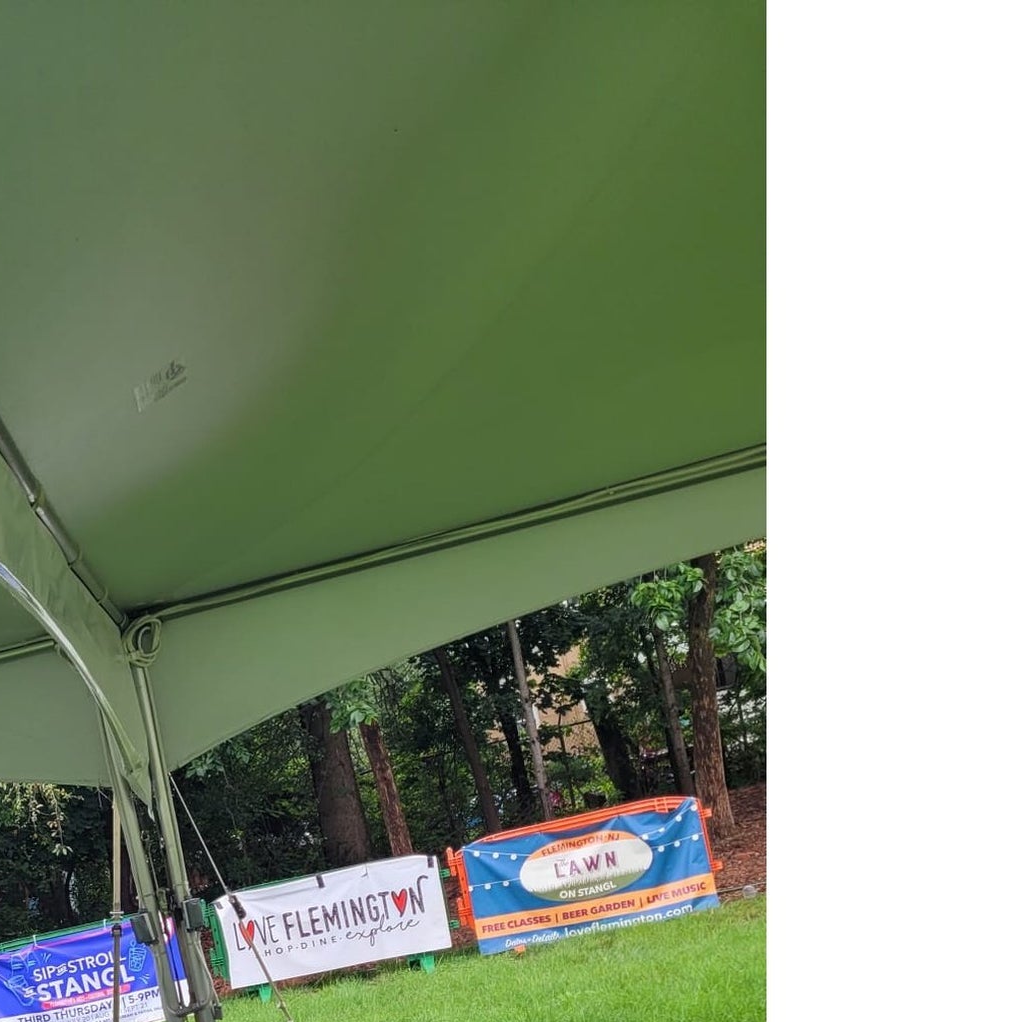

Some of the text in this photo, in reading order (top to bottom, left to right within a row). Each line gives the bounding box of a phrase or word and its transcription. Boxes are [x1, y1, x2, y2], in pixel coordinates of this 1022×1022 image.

[554, 851, 618, 878] LAWN
[559, 881, 618, 899] ON STANGL
[282, 874, 429, 941] FLEMINGTON
[482, 922, 507, 933] FREE
[507, 914, 552, 929] CLASSES
[562, 908, 588, 920] BEER
[590, 899, 635, 915] GARDEN
[646, 892, 670, 904] LIVE
[671, 881, 707, 898] MUSIC
[257, 945, 294, 958] HOP
[37, 964, 136, 1002] STANGL
[53, 1000, 114, 1020] THURSDAY
